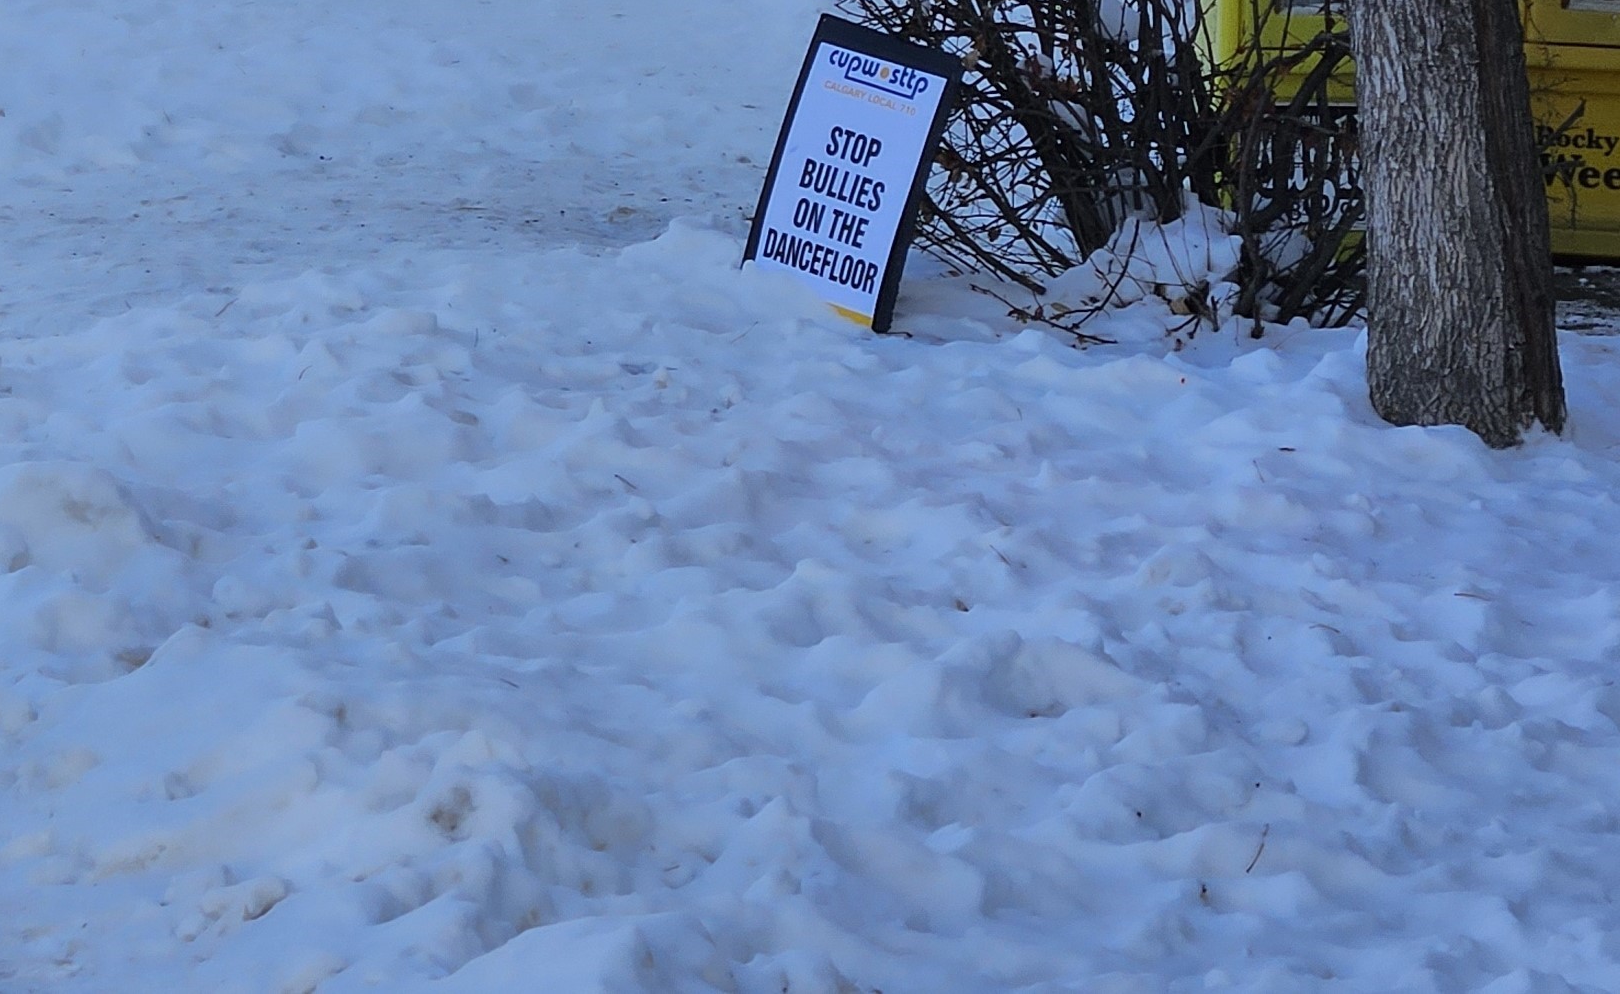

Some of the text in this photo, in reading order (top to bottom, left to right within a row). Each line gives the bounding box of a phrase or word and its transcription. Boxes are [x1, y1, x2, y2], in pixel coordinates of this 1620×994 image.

[824, 80, 916, 116] CALGARY LOCAL 710
[825, 125, 882, 168] STOP
[1536, 125, 1620, 157] Rocky
[799, 158, 885, 212] BULLIES
[793, 197, 870, 249] ON THE
[762, 227, 878, 295] DANCEFLOOR
